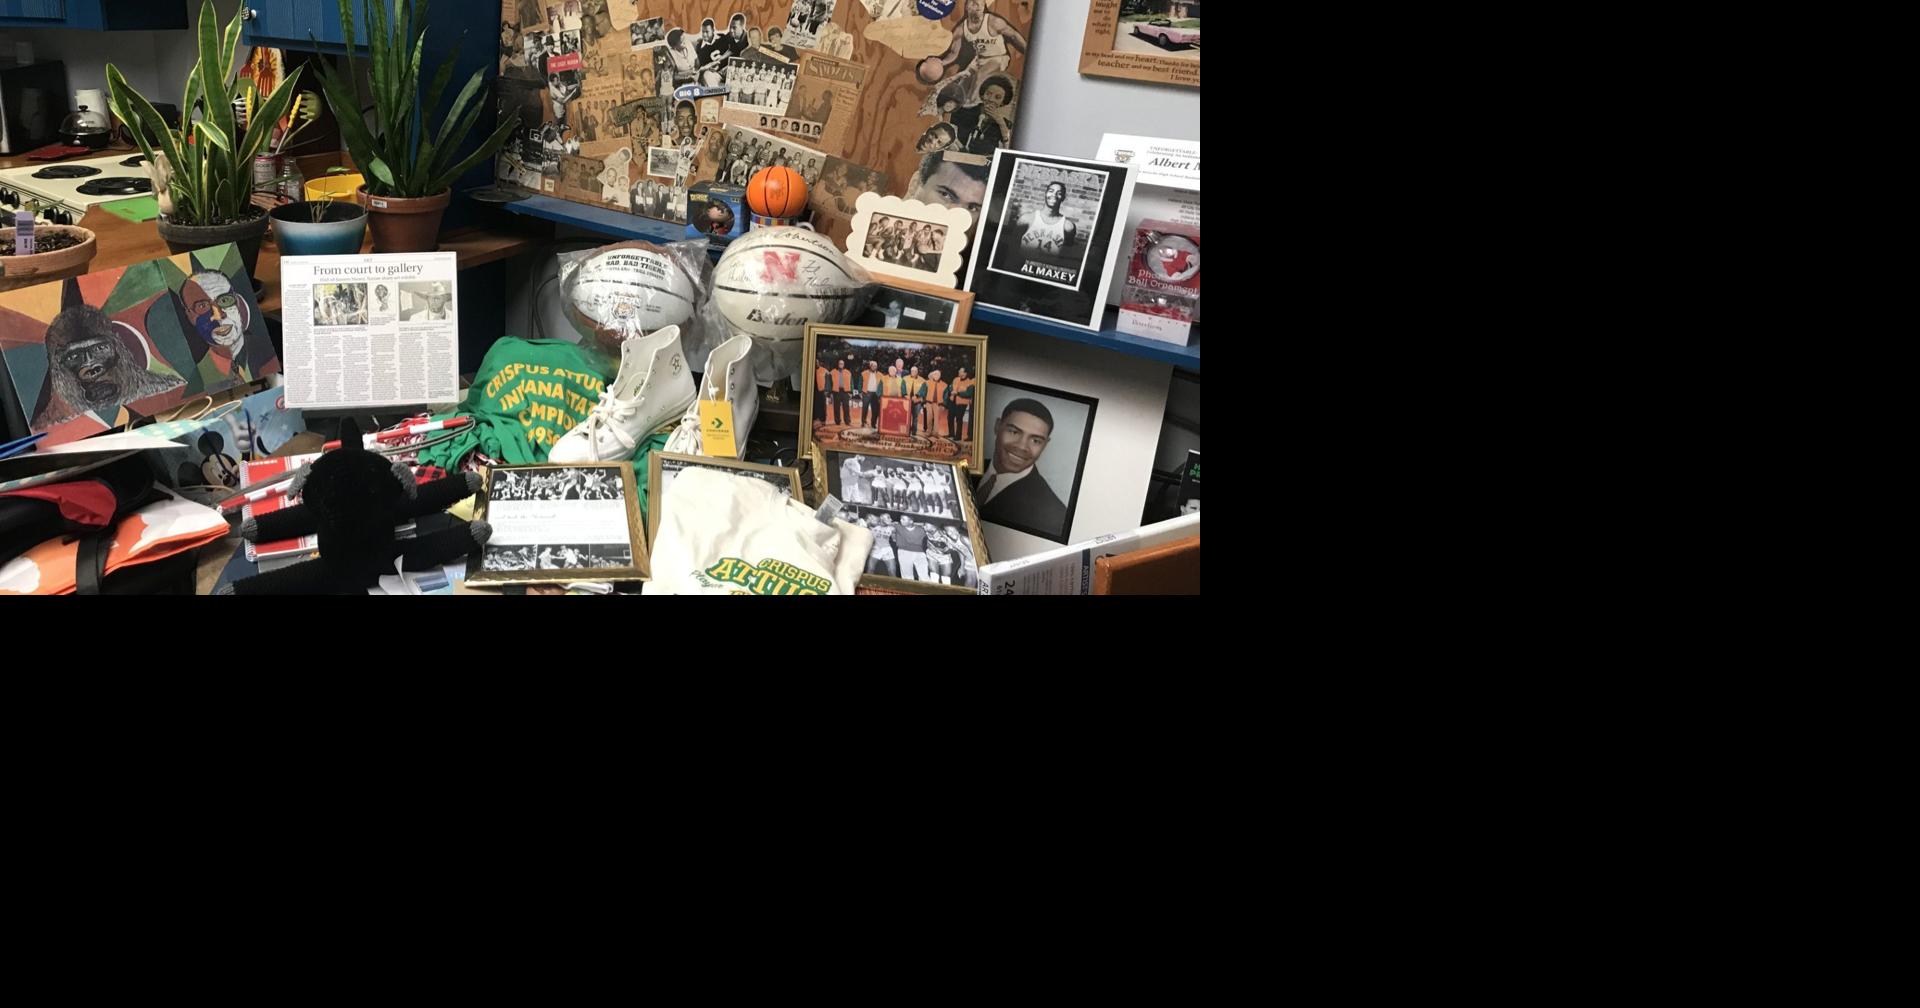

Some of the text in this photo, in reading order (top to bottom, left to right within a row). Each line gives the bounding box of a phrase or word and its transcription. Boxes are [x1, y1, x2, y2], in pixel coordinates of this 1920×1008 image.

[1098, 60, 1130, 69] teacher
[1149, 158, 1190, 170] Albert
[314, 262, 423, 276] From court to gallery
[640, 262, 665, 275] TIGERS
[760, 251, 800, 284] N
[1021, 264, 1034, 274] AL
[1036, 268, 1075, 282] MAXEY
[1128, 276, 1148, 287] Ball
[486, 363, 550, 398] CRISPUS
[553, 368, 605, 394] ATTUC
[758, 558, 831, 592] CRISPUS
